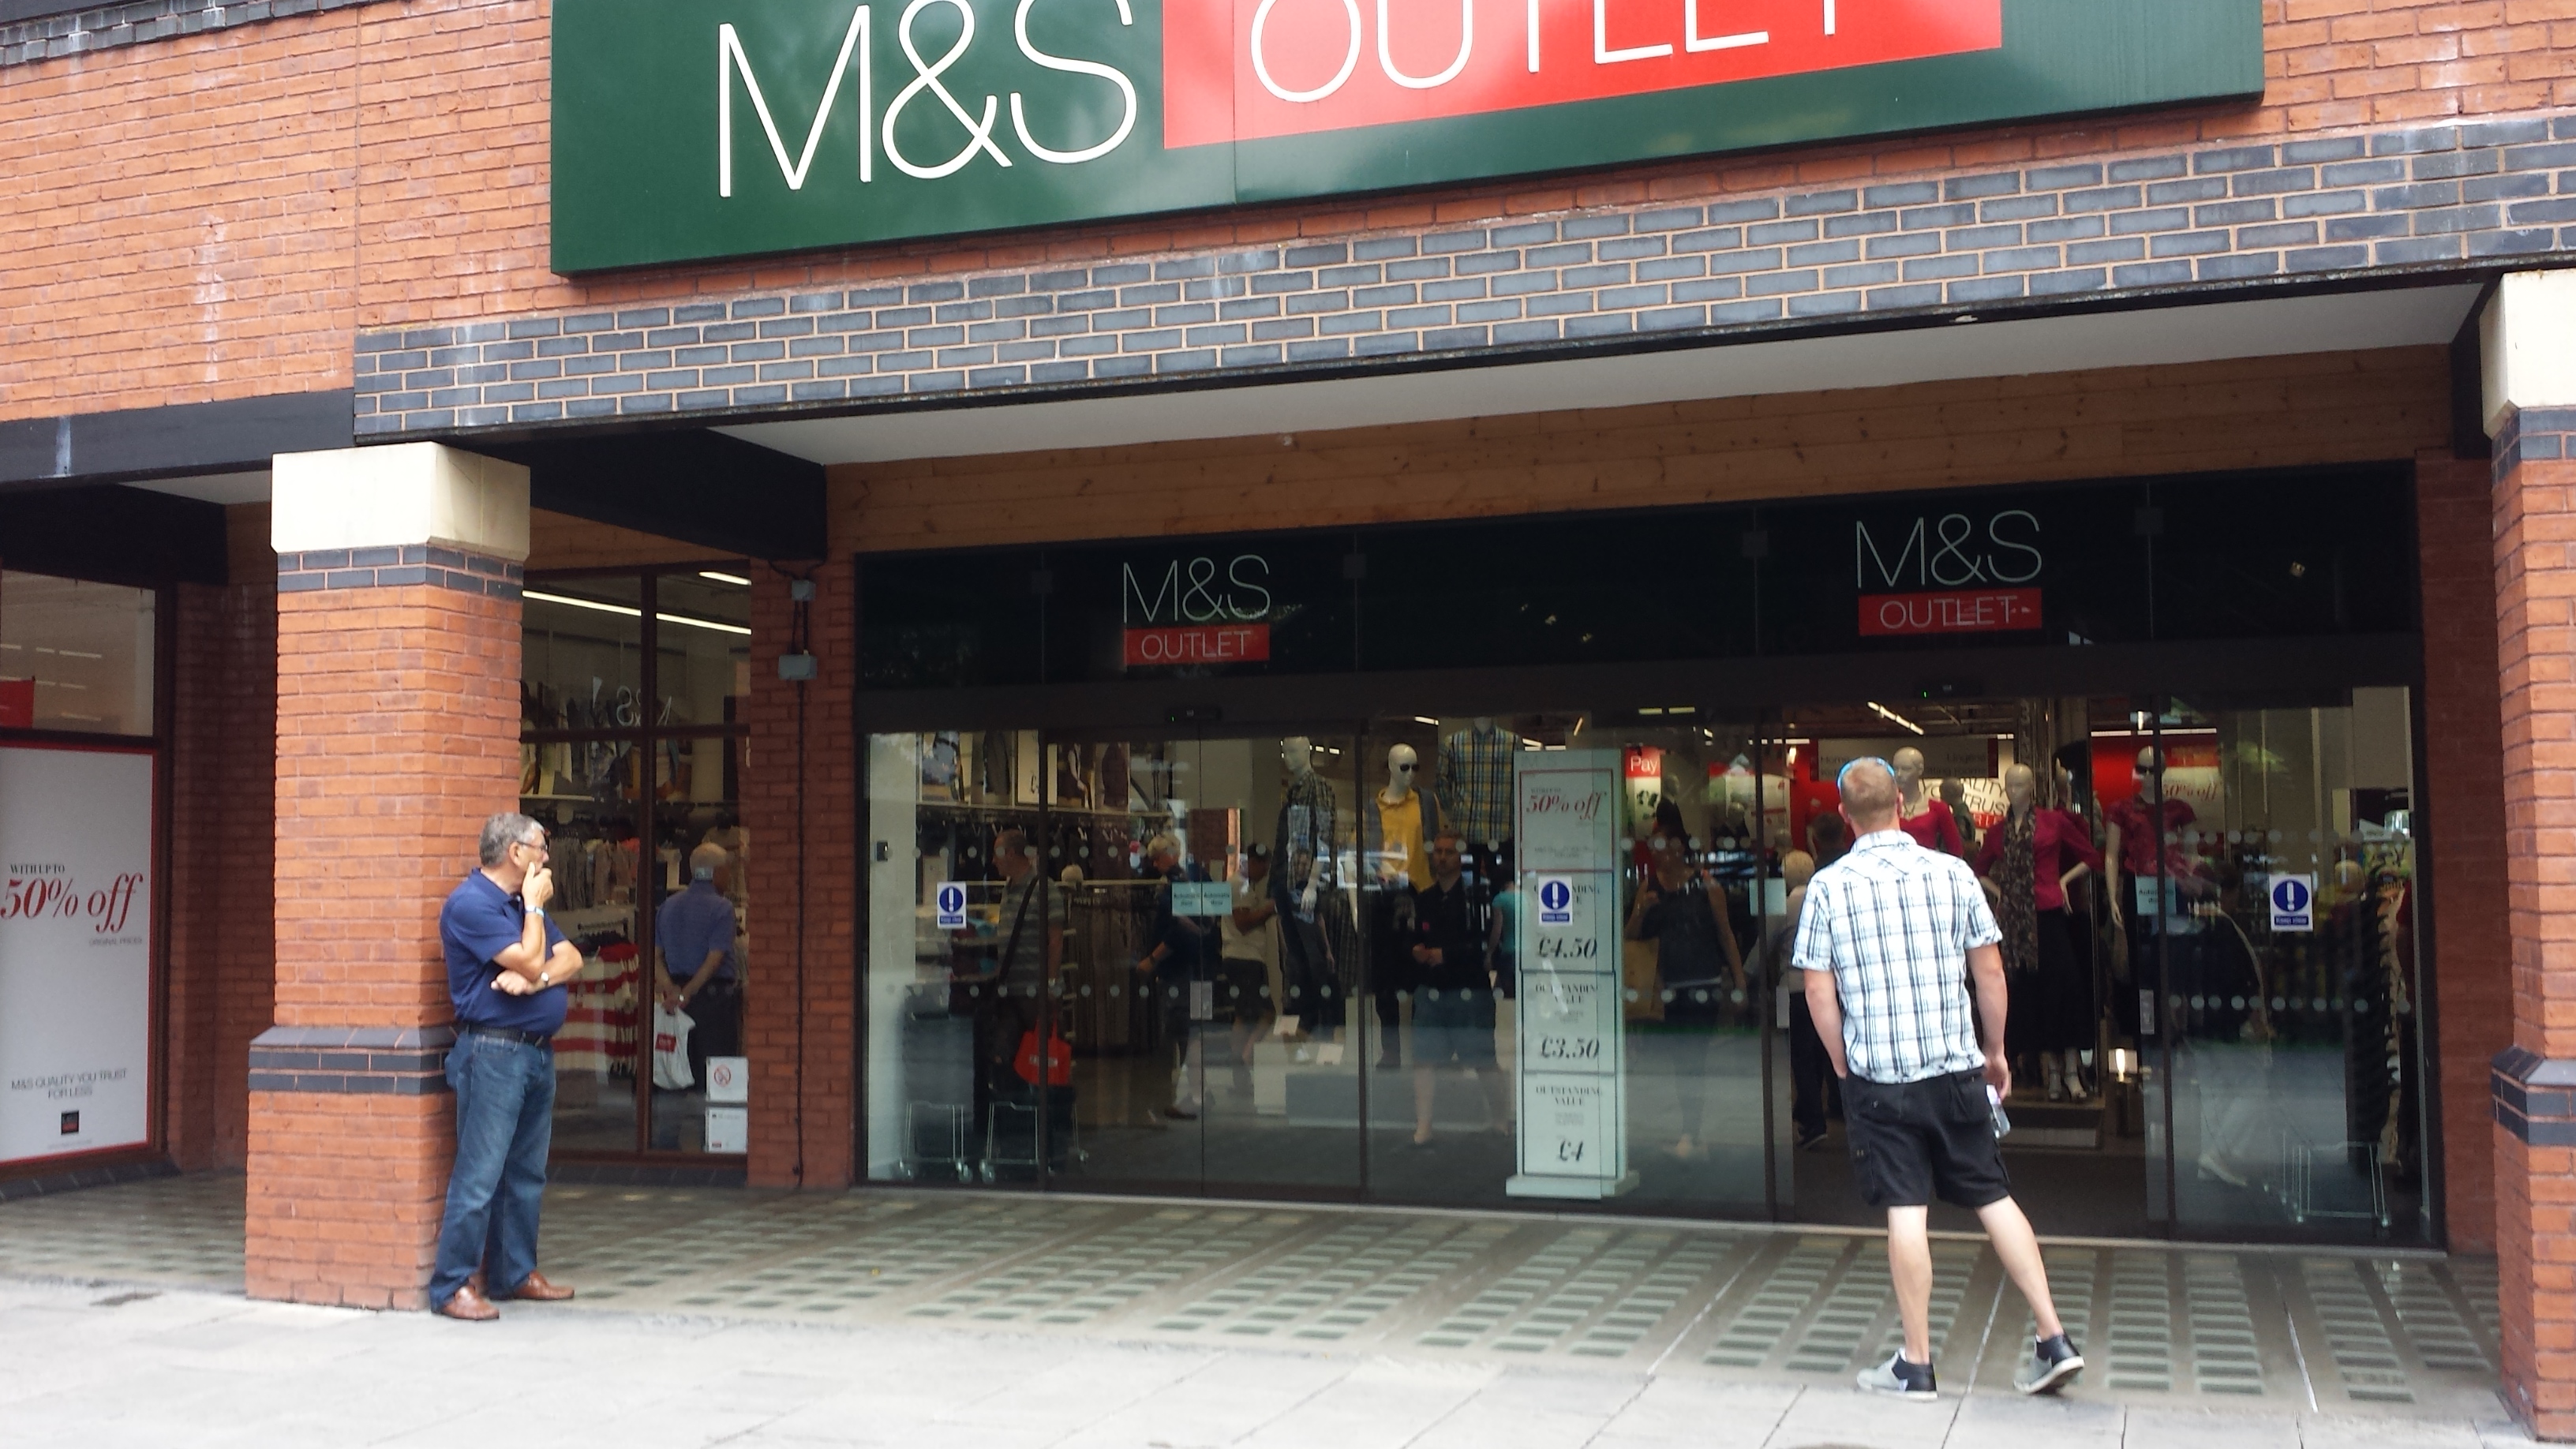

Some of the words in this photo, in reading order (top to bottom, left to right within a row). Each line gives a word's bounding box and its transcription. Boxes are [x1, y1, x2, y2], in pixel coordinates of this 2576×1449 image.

[718, 0, 1138, 197] M&S
[1856, 510, 2042, 589] M&S
[1124, 554, 1271, 623] M&S
[1880, 595, 2018, 629] OUTLET
[1141, 630, 1252, 660] OUTLET
[1630, 755, 1658, 775] Pay
[1963, 778, 2006, 798] ALITY
[1526, 795, 1570, 814] 50%
[1574, 792, 1608, 820] off
[1964, 792, 2005, 816] TRUS
[0, 878, 79, 919] 50%
[87, 872, 144, 934] off
[1538, 938, 1597, 958] £4.50
[1541, 1036, 1600, 1058] £3.50
[36, 1073, 75, 1088] QUALITY
[1558, 1140, 1584, 1162] £4
